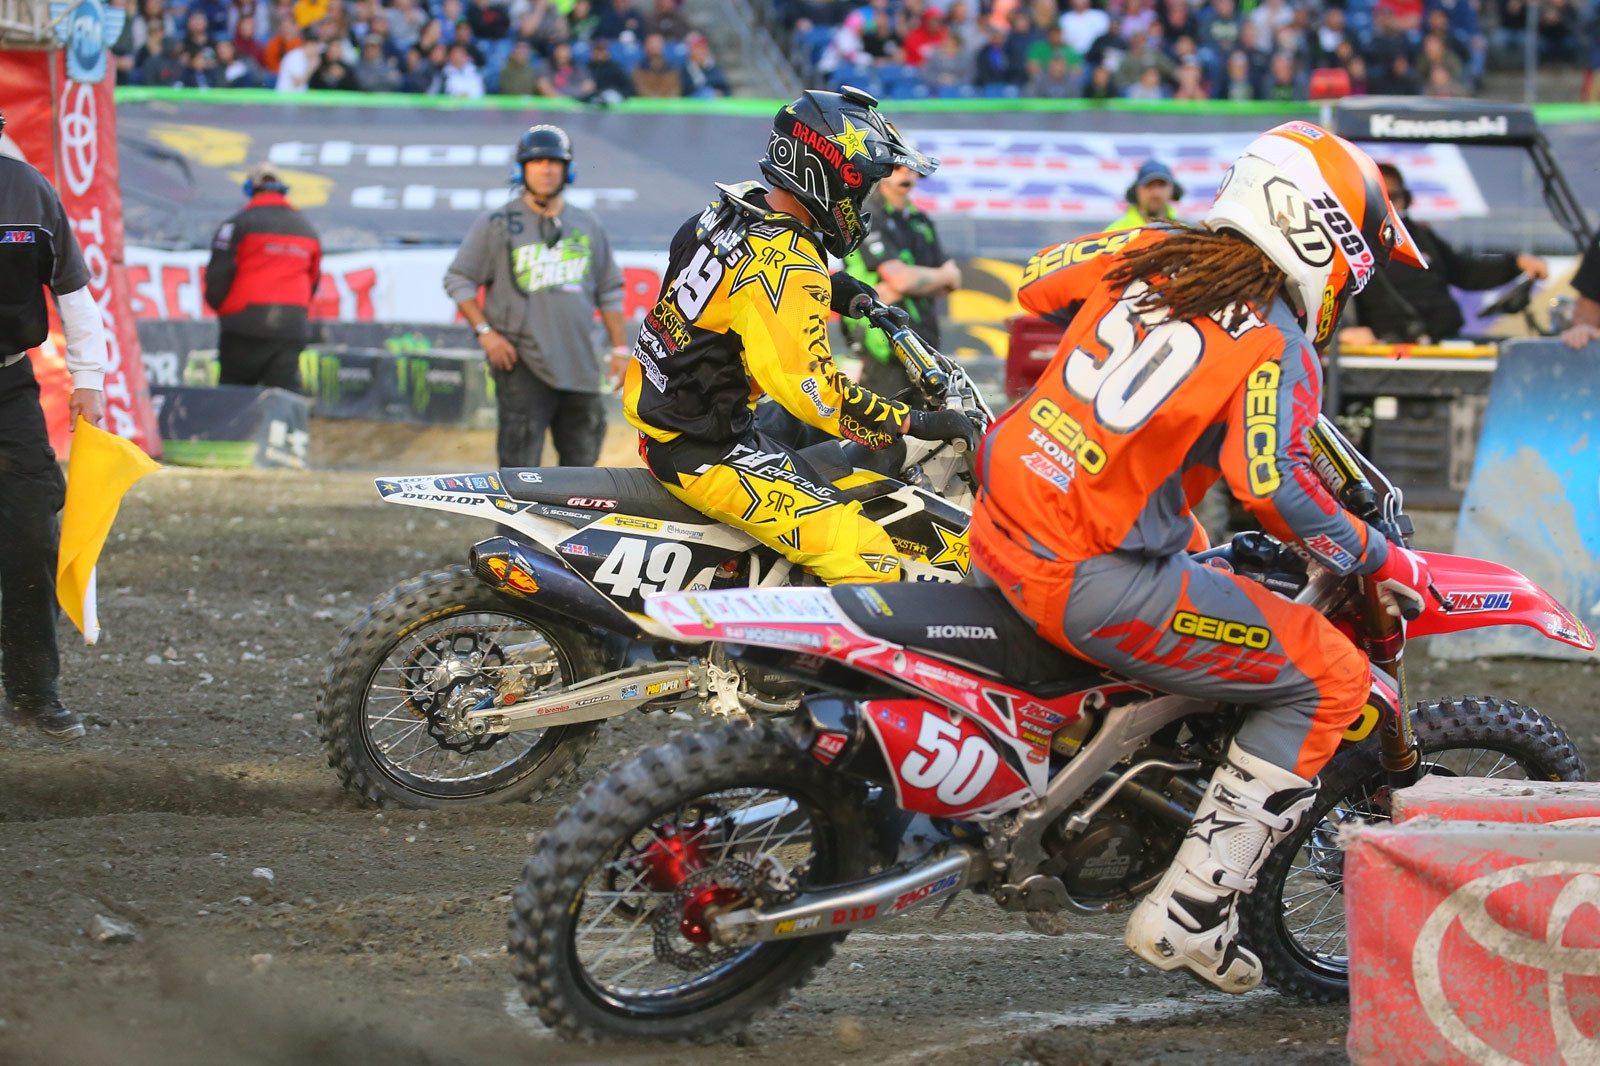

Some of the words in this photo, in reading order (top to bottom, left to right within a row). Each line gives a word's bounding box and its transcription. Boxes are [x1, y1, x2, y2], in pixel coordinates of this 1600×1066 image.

[1370, 115, 1508, 136] Kawasaki
[791, 121, 844, 170] DRAGON
[1311, 191, 1376, 280] 100%
[529, 256, 589, 292] CREW
[1314, 284, 1337, 344] GEICO
[1063, 279, 1206, 434] 50
[1246, 360, 1281, 497] GEICO
[401, 492, 486, 506] DUNLOP
[753, 464, 837, 497] RACING
[550, 509, 592, 520] SCOSCHE
[567, 497, 617, 509] GUTS
[592, 536, 693, 600] 49
[1305, 533, 1358, 571] AMSOIL
[1440, 592, 1512, 613] AMSOIL
[927, 625, 998, 640] HONDA
[1172, 611, 1270, 649] GEICO
[646, 678, 680, 696] PROTAPER
[1020, 720, 1052, 737] DUNLO
[900, 710, 999, 806] 50
[883, 872, 961, 916] AMSOIL
